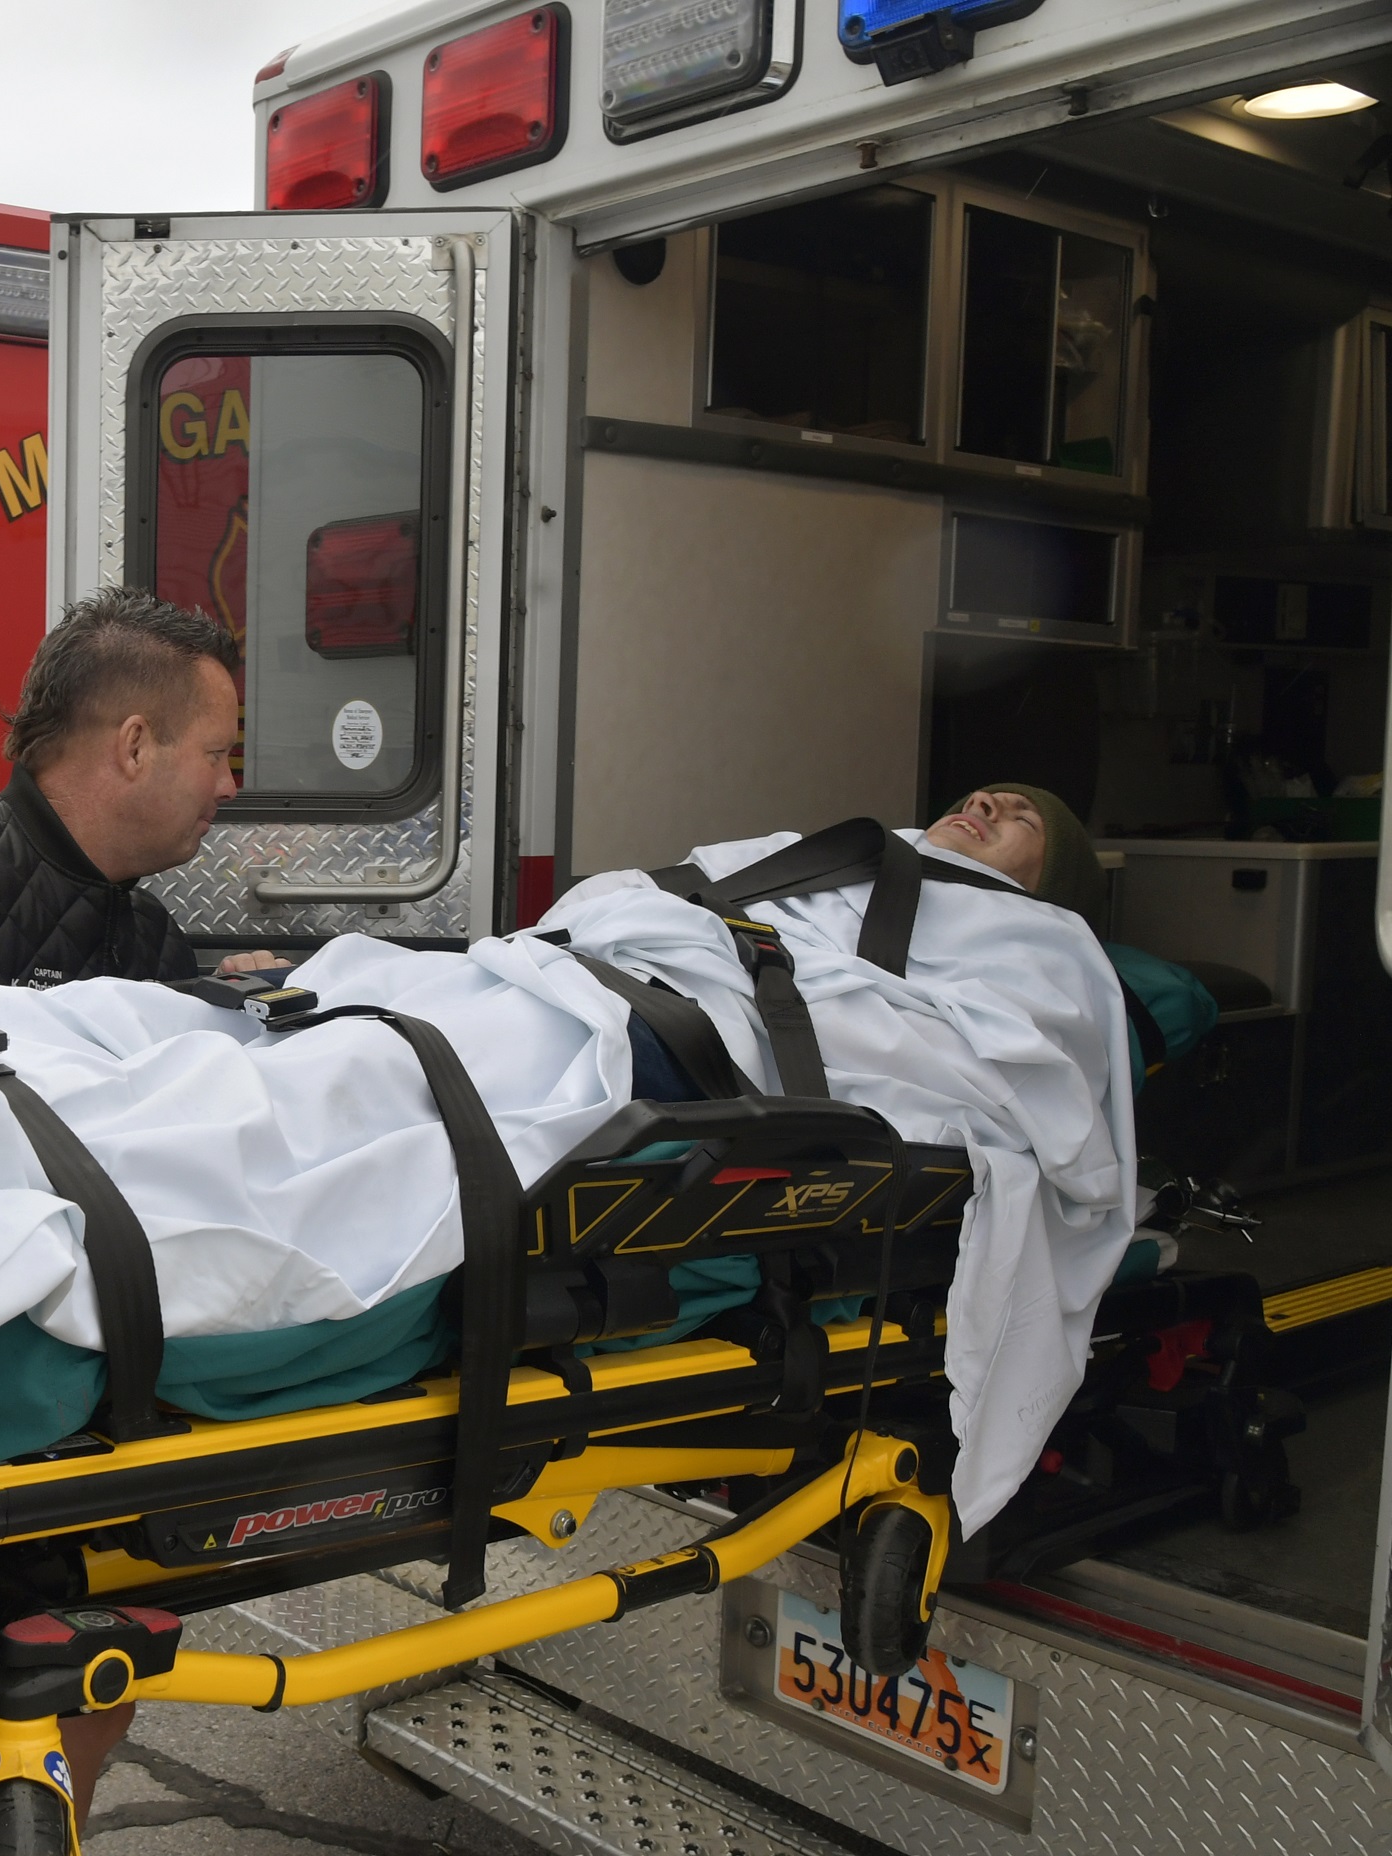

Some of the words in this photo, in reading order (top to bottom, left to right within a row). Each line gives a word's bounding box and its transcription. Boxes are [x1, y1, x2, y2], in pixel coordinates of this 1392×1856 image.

[34, 967, 63, 979] CAPTAIN
[771, 1181, 855, 1212] XPS
[227, 1489, 387, 1548] power
[382, 1487, 447, 1519] pro
[793, 1631, 964, 1755] 530475
[831, 1705, 861, 1722] LIFE
[867, 1719, 943, 1759] ELEVATED
